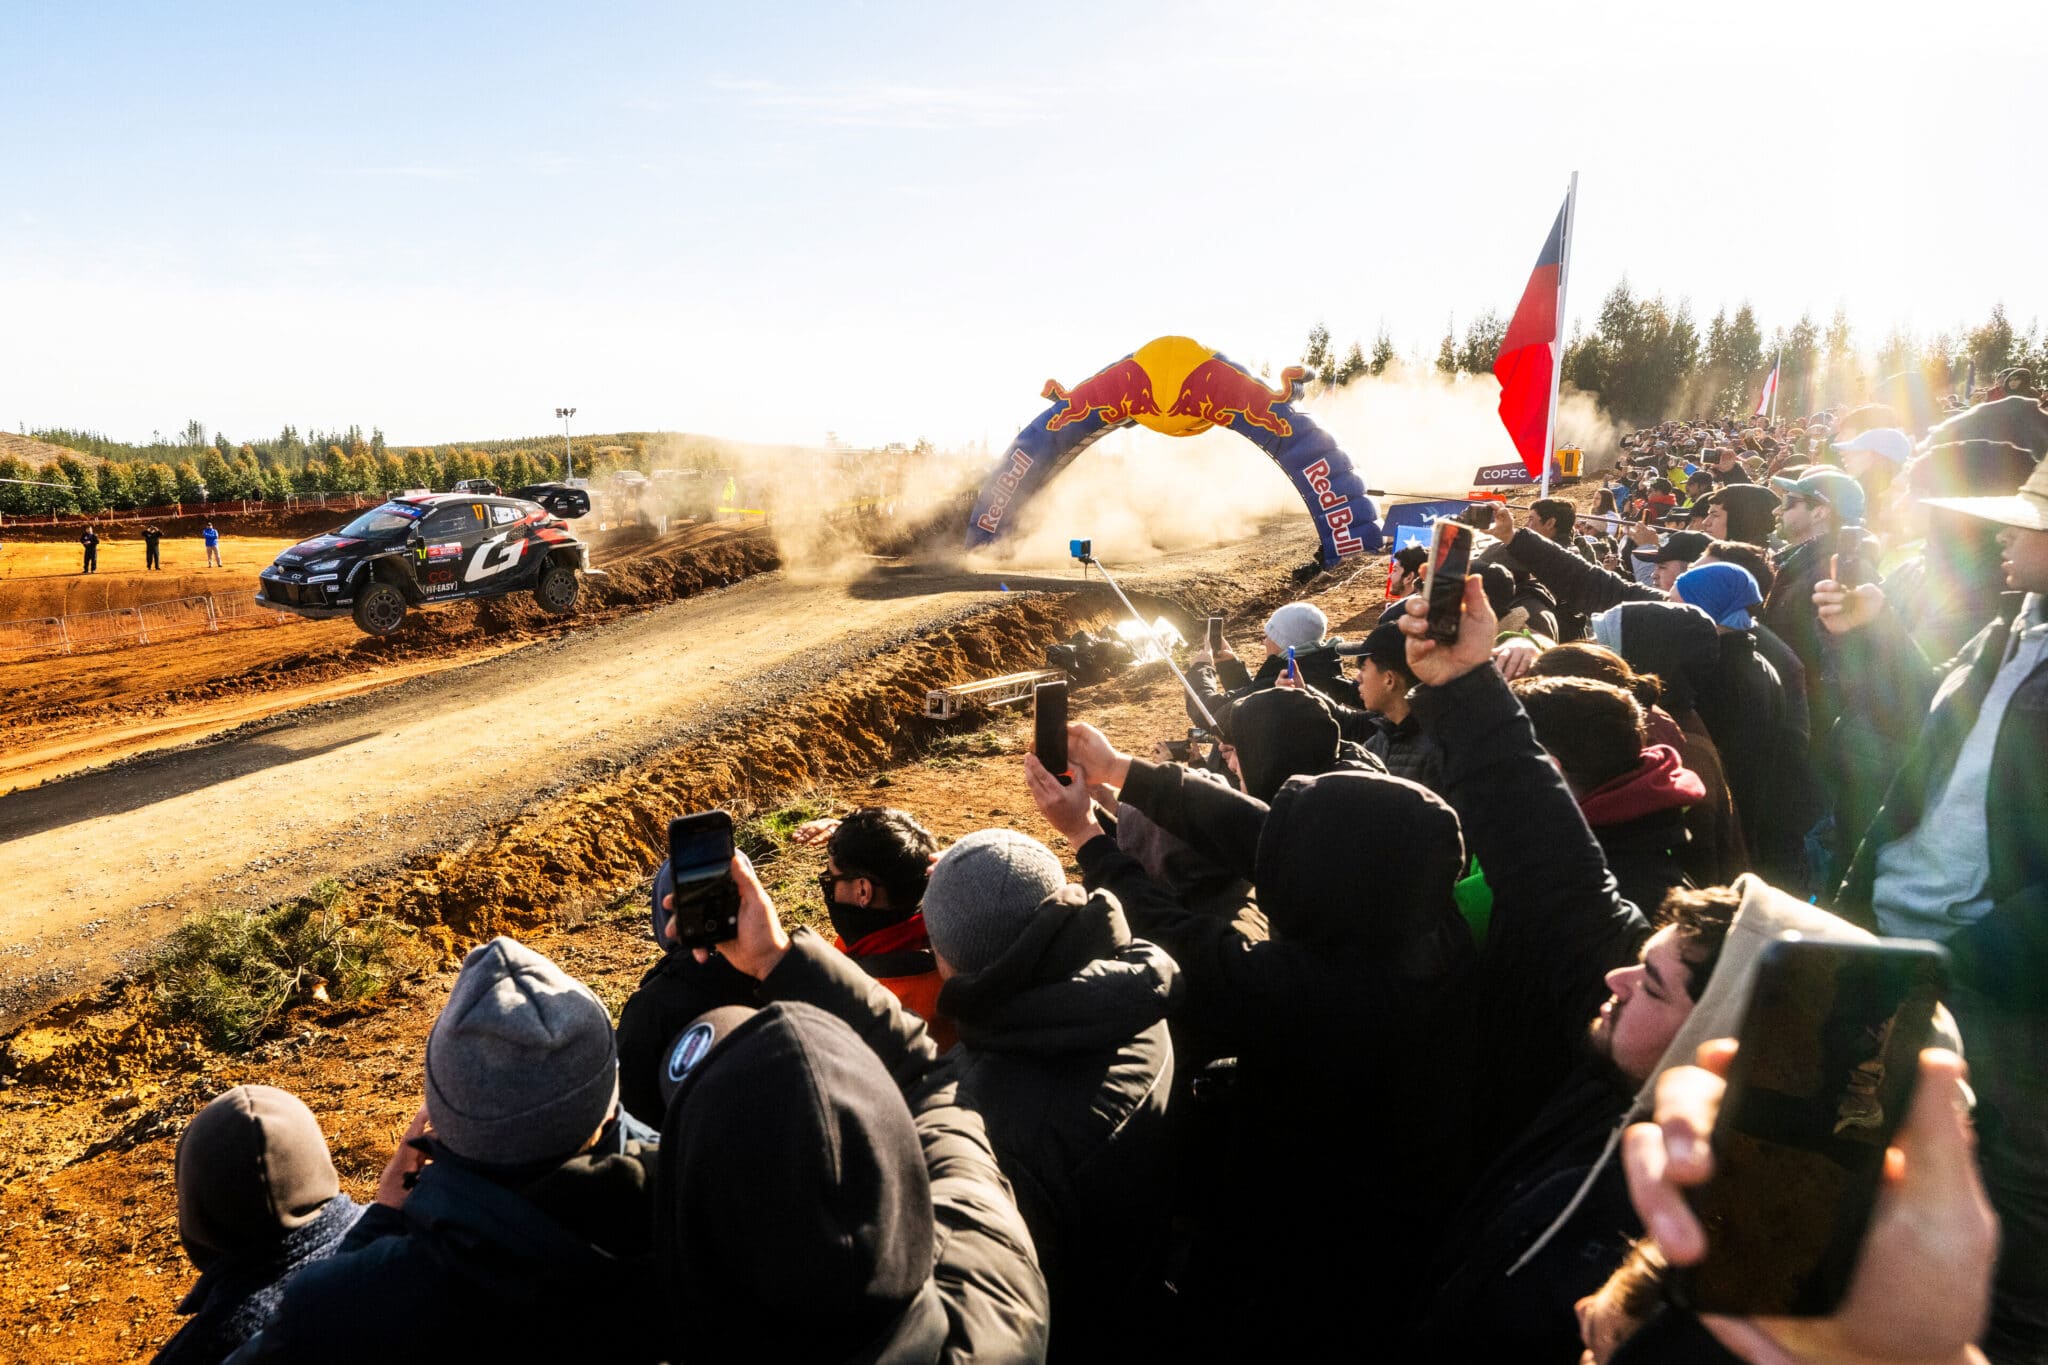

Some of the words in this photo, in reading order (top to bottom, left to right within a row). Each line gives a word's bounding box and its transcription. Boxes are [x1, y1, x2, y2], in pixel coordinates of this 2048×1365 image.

[977, 486, 1011, 534] Red
[997, 447, 1034, 493] Bull
[1303, 457, 1348, 511] Red
[1482, 468, 1527, 480] COPEC
[472, 503, 484, 520] 17
[1325, 506, 1364, 556] Bull
[416, 547, 427, 560] 17
